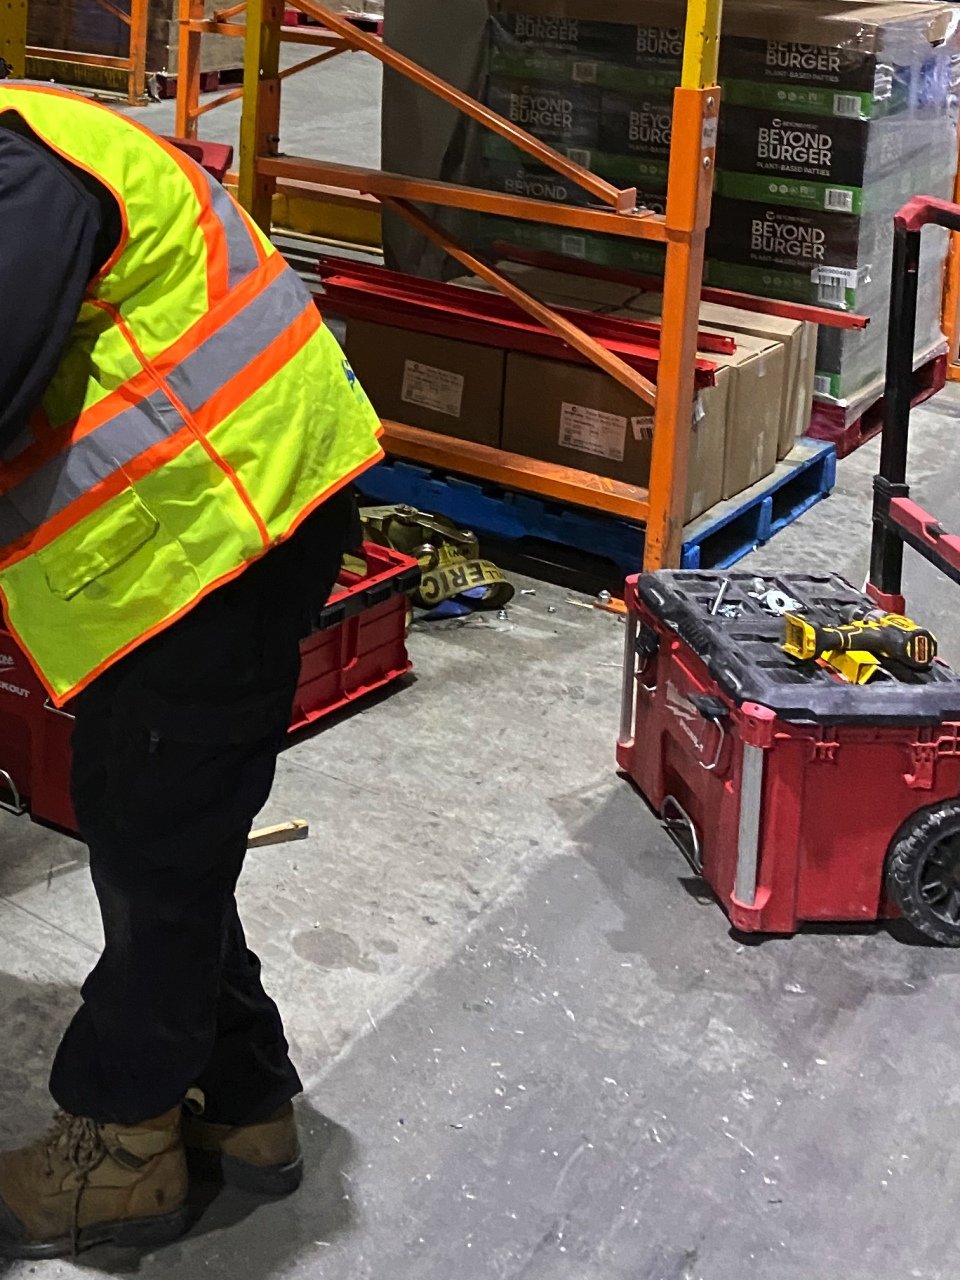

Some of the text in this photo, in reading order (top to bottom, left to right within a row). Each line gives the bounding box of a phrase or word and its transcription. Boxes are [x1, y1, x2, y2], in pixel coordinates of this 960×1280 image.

[515, 23, 578, 41] BURGER
[637, 27, 682, 40] BEYO
[637, 39, 682, 55] BURG
[766, 50, 840, 71] BURGER
[765, 70, 839, 82] PLANT-BASED PATTIES
[510, 93, 572, 112] BEYOND
[509, 108, 573, 128] BURGER
[629, 111, 671, 128] BEYO
[629, 127, 671, 144] BURG
[758, 127, 832, 150] BEYOND
[757, 144, 832, 166] BURGER
[757, 161, 830, 177] PLANT-BASED PATTIES
[505, 179, 567, 200] BEYOND
[752, 219, 825, 243] BEYOND
[751, 234, 825, 260] BURGER
